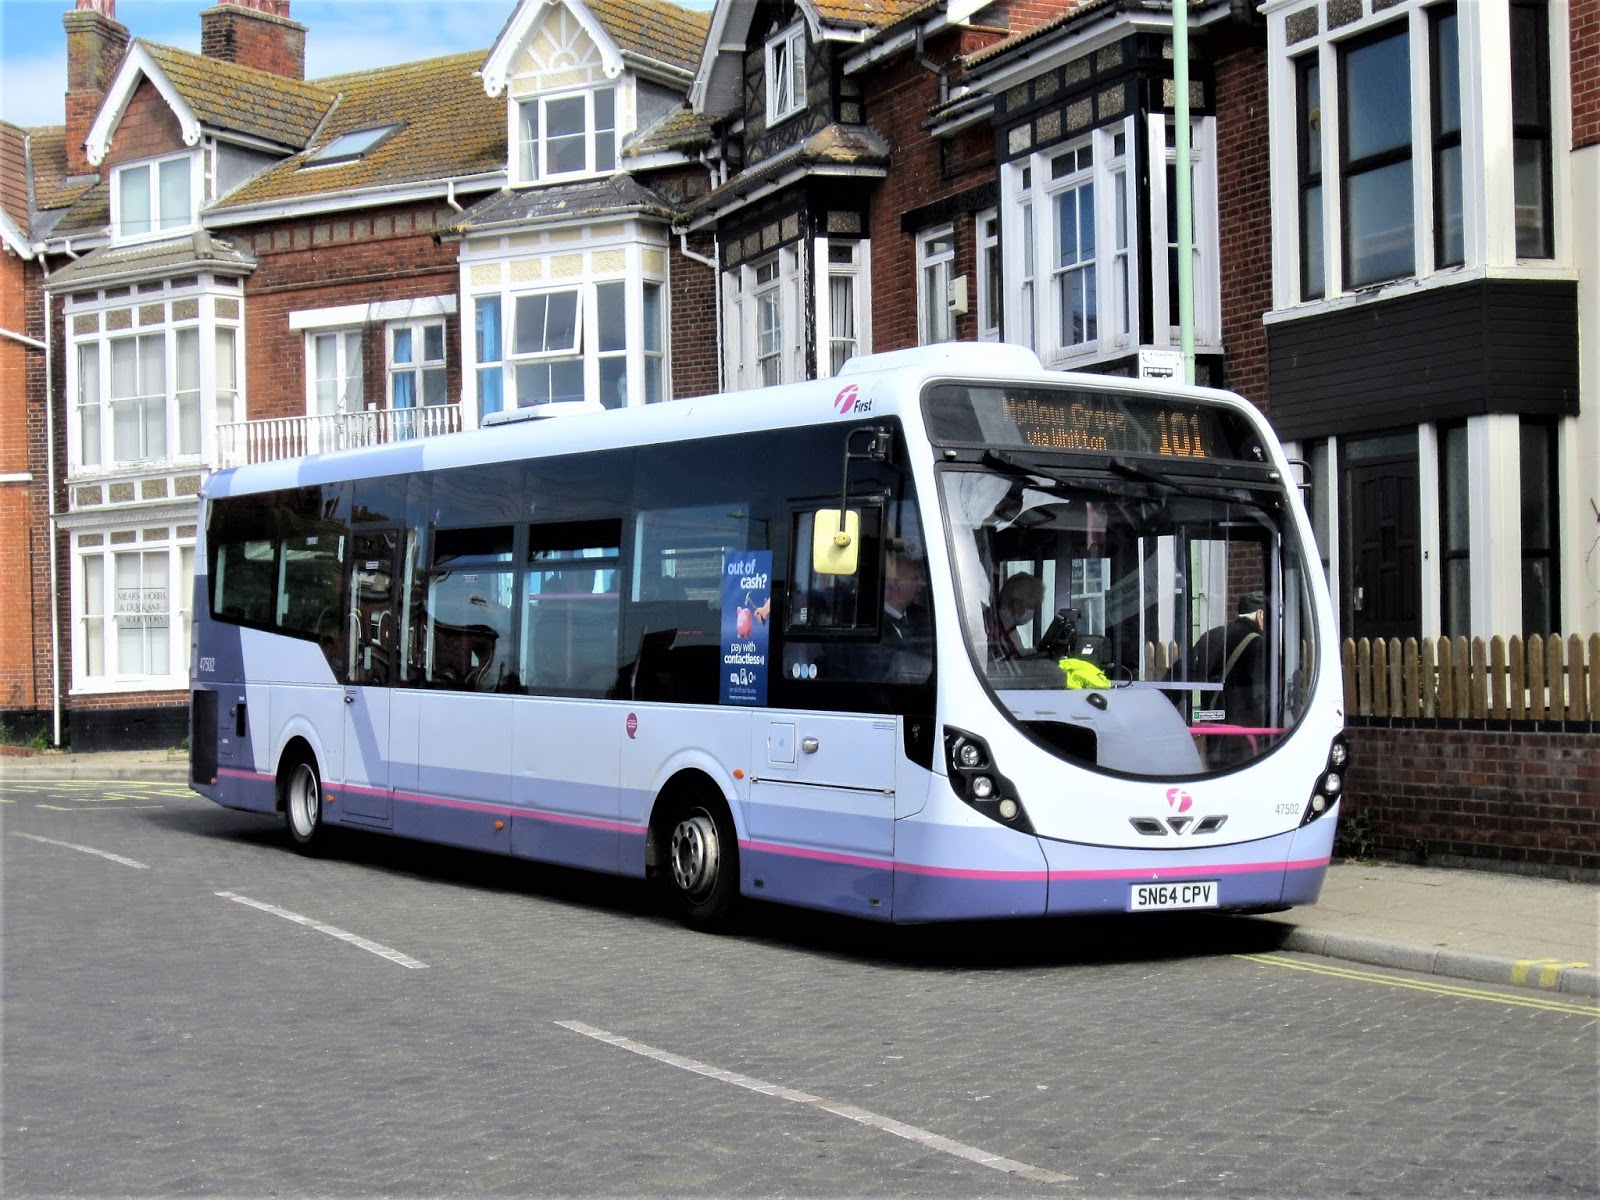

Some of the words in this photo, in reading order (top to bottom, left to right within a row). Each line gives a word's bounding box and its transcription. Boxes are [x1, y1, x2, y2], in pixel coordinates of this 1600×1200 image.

[853, 399, 873, 413] First
[1070, 403, 1126, 431] Grove
[1027, 427, 1049, 447] via
[1051, 427, 1107, 450] Whitton
[1156, 411, 1205, 458] 101
[727, 560, 744, 575] out
[744, 558, 756, 575] of
[740, 573, 768, 589] cash?
[730, 643, 742, 654] pay
[742, 641, 756, 652] with
[199, 657, 215, 671] 47502
[724, 653, 760, 665] contactless
[1274, 803, 1300, 815] 47502
[1138, 887, 1178, 905] SN64
[1182, 885, 1211, 903] CPV
